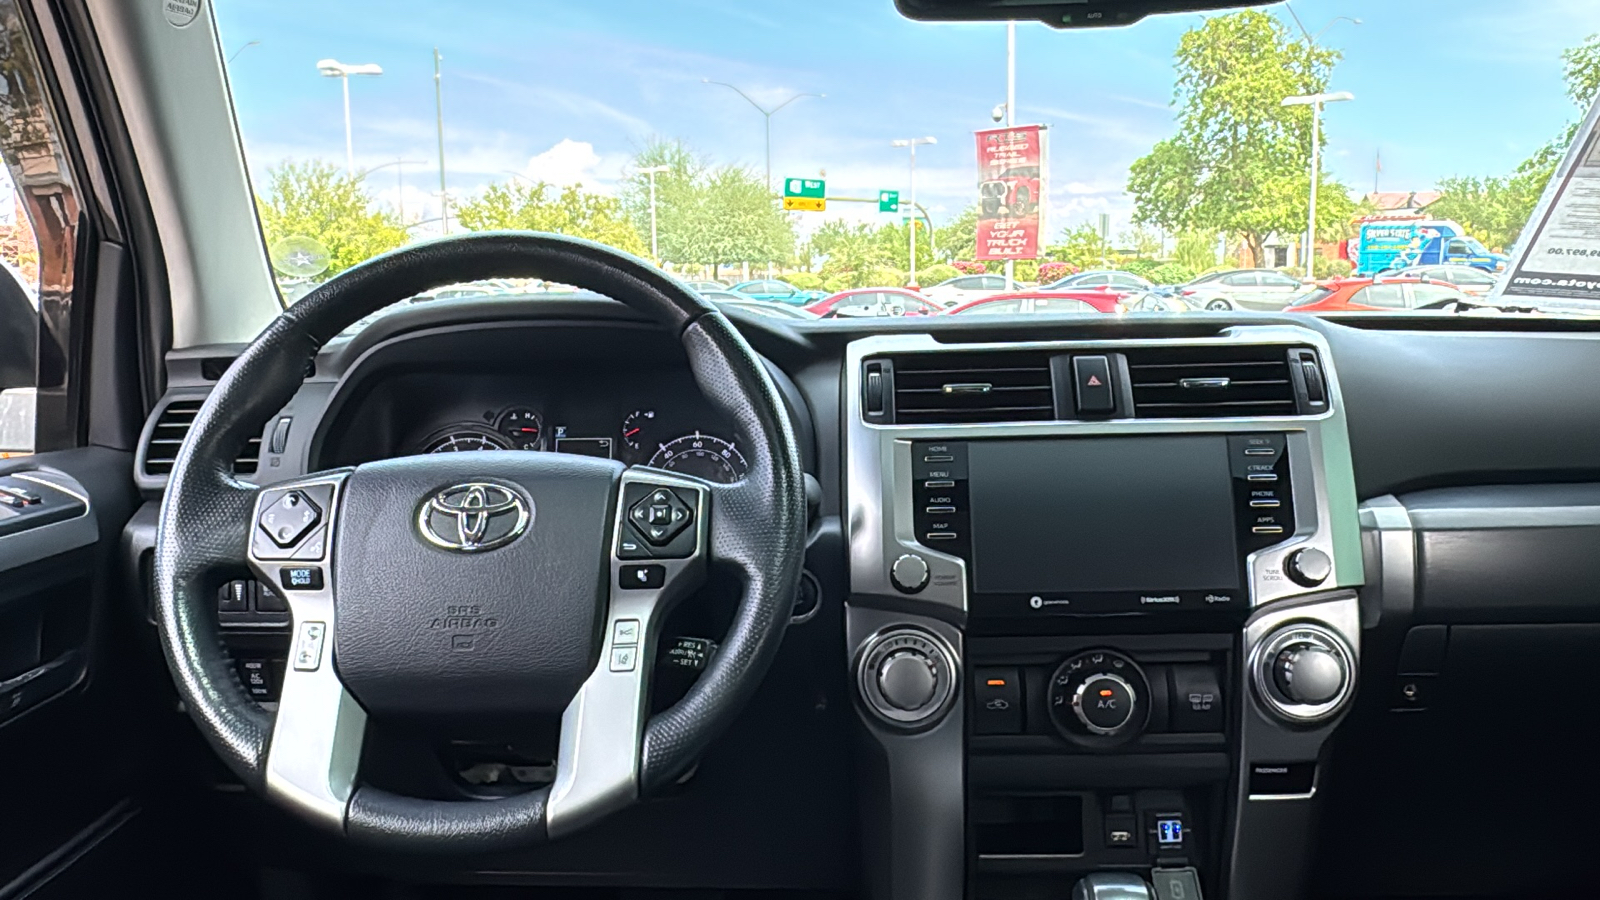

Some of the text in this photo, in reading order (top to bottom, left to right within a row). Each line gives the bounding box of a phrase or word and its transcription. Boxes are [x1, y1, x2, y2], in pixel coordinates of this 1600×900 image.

[990, 229, 1025, 238] YOUR
[987, 238, 1028, 247] TRUCK
[557, 428, 565, 437] P
[290, 569, 310, 577] MODE
[447, 606, 481, 615] SRS
[430, 618, 499, 629] AIRBAG
[1097, 699, 1117, 709] A/C
